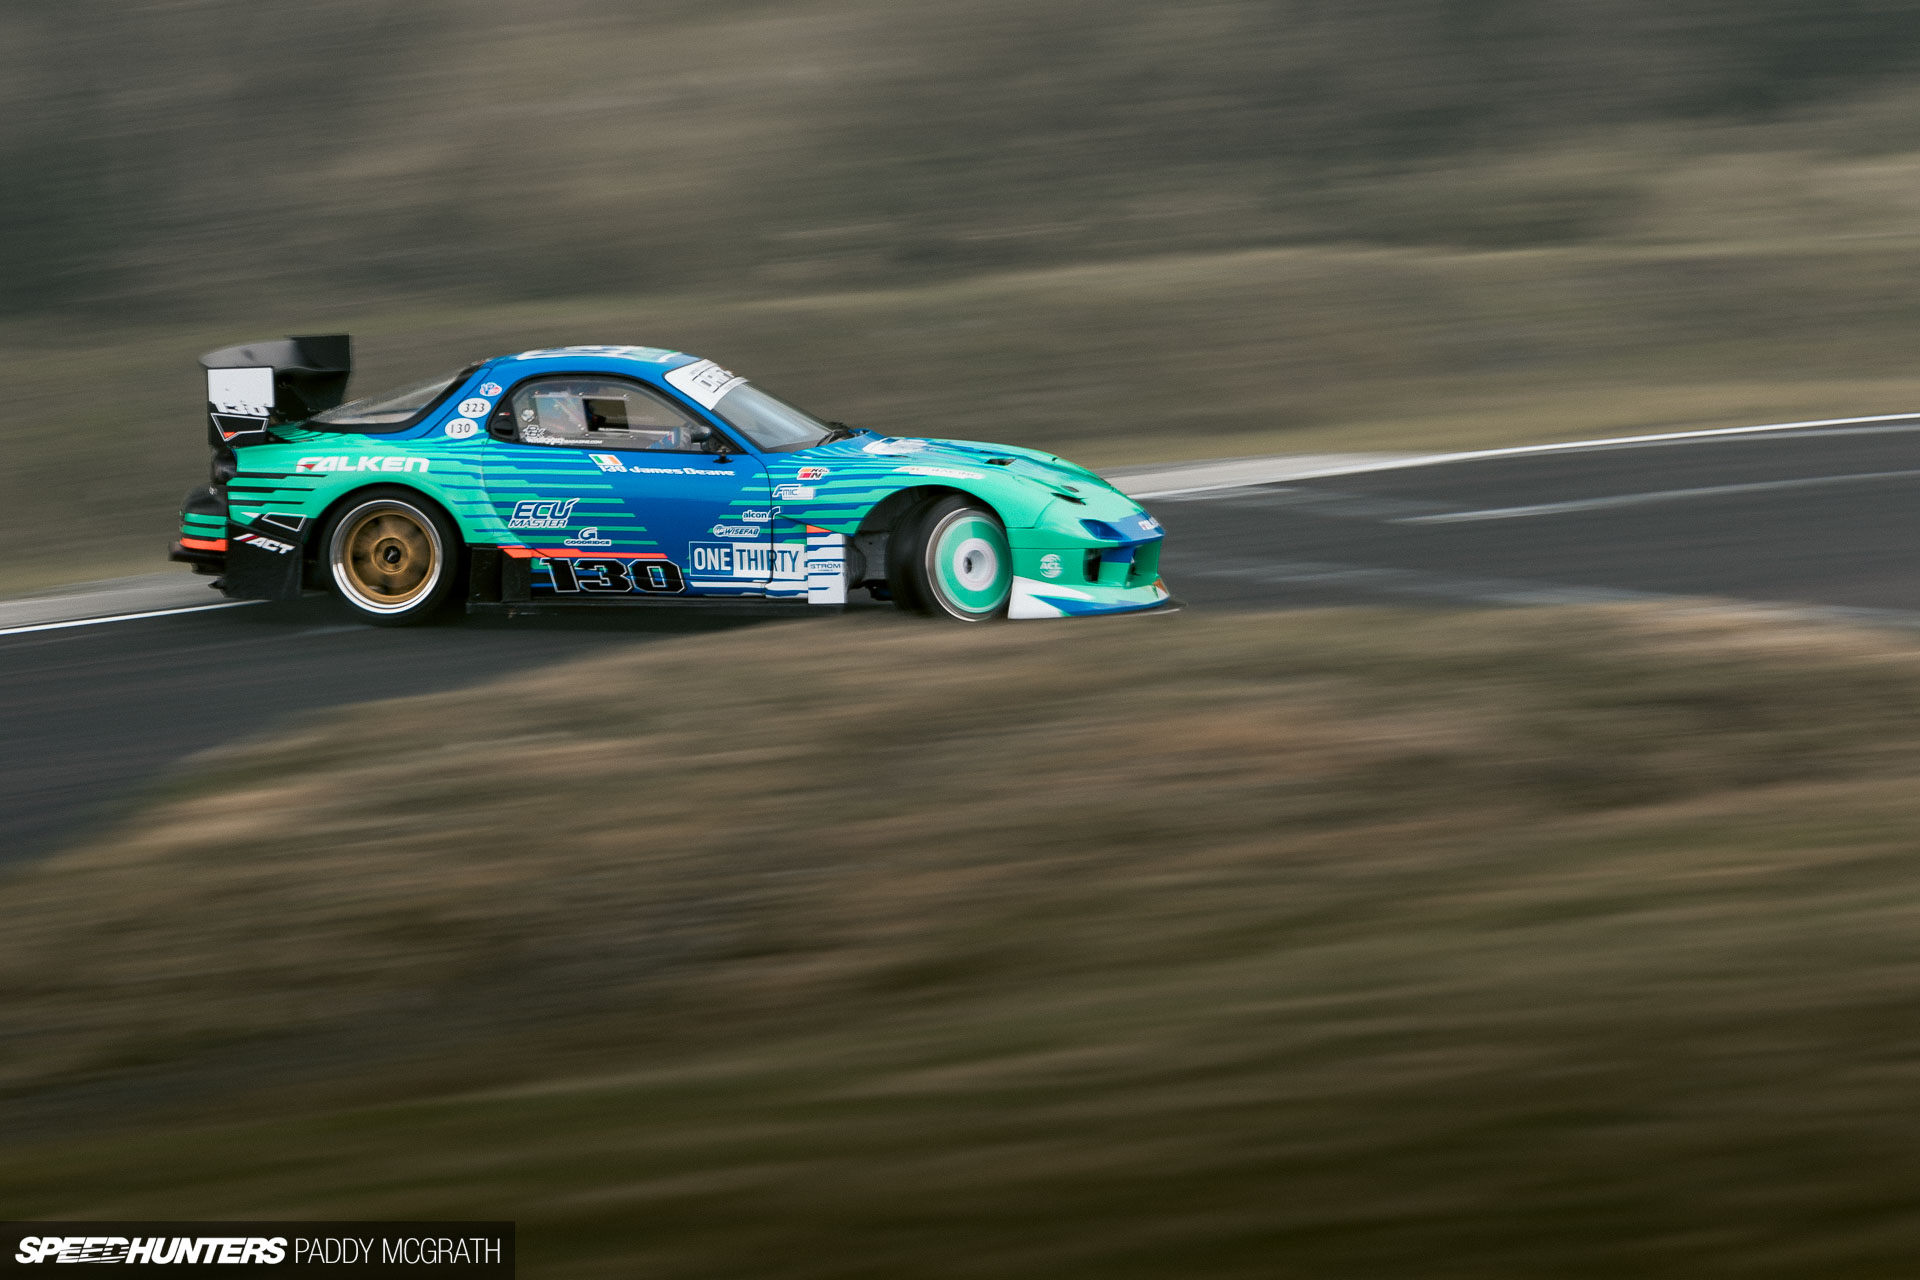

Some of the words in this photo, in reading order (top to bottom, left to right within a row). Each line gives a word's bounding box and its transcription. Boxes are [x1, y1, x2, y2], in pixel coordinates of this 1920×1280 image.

[463, 403, 485, 413] 323
[450, 423, 471, 434] 130
[295, 456, 431, 473] FALKEN
[629, 465, 683, 475] James
[683, 467, 736, 477] Deane
[512, 498, 580, 520] ECU
[743, 510, 768, 519] alcon
[508, 519, 568, 528] MASTER
[725, 527, 760, 536] WISEFAB
[693, 547, 732, 571] ONE
[735, 548, 800, 573] THIRTY
[539, 558, 686, 593] 130
